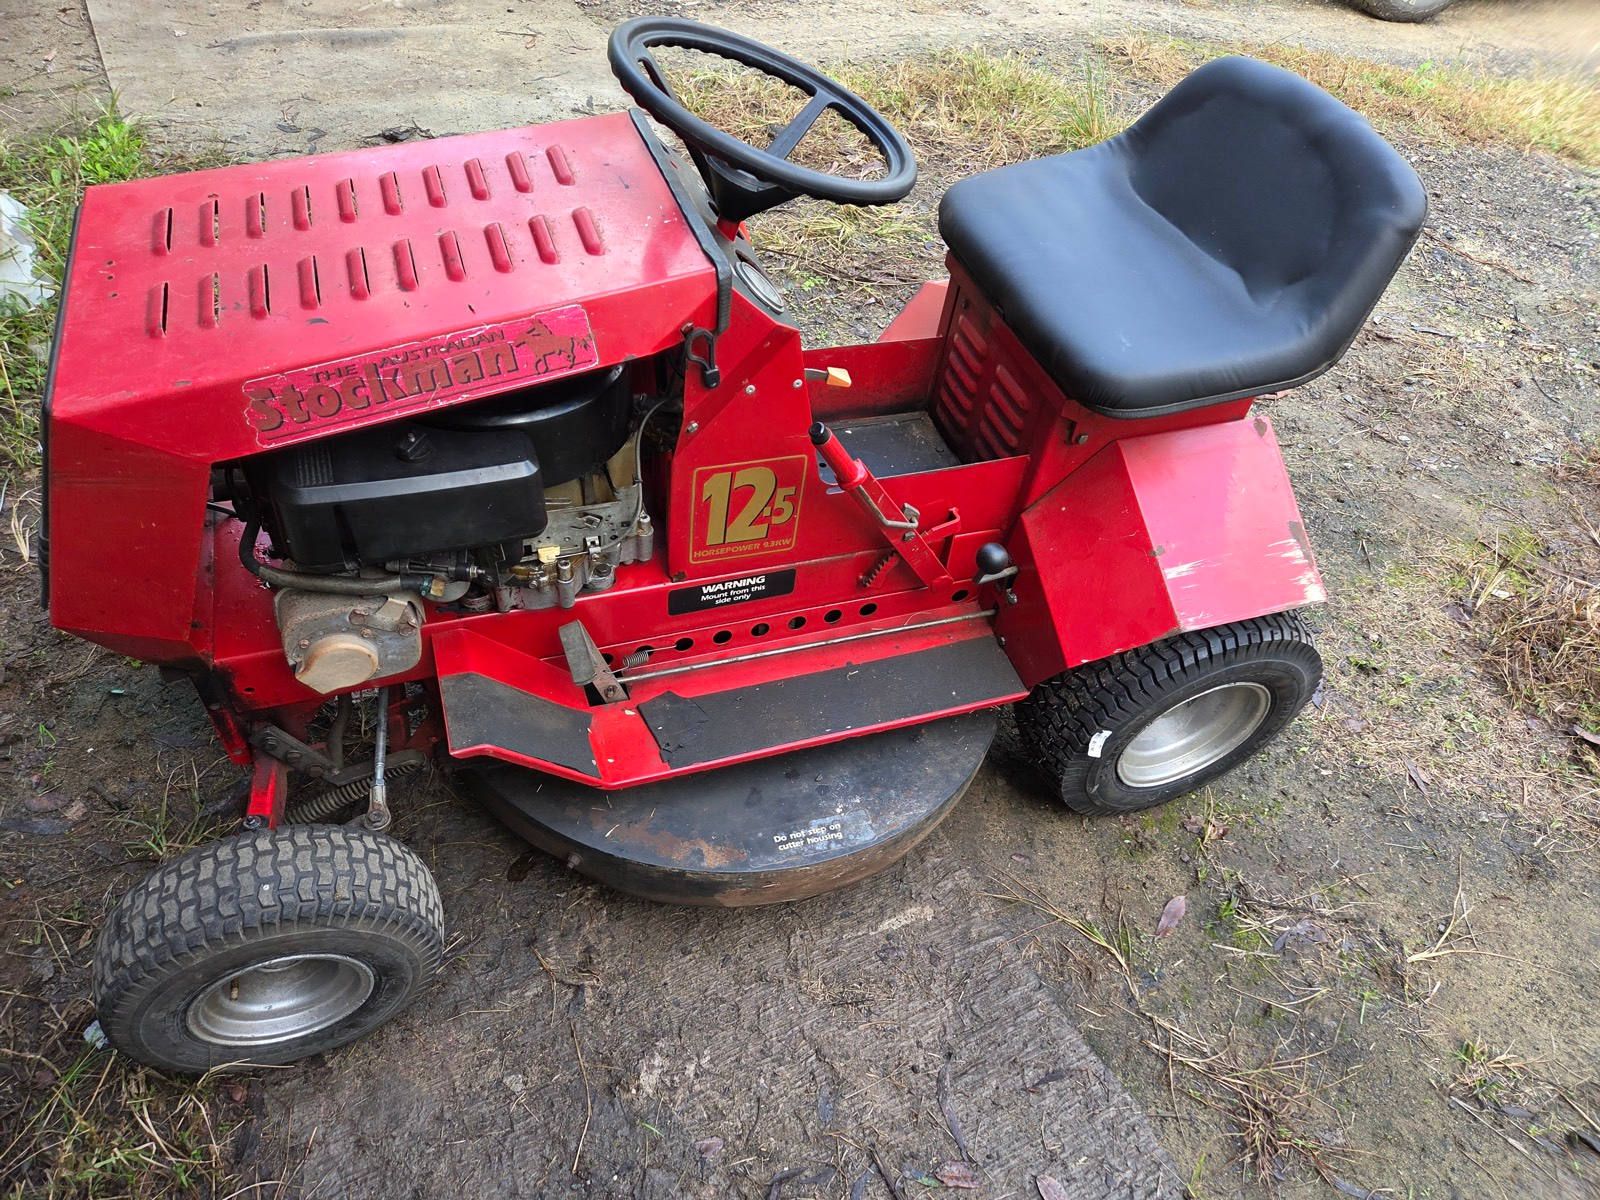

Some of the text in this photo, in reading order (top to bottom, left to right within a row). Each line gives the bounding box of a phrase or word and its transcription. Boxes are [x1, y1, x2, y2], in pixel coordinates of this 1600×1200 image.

[313, 329, 505, 383] THE AUSTRALIAN
[249, 341, 520, 432] Stockman
[693, 543, 761, 558] HORSEPOWER
[701, 584, 766, 602] Mount from this
[702, 575, 766, 594] WARNING
[715, 593, 752, 605] side only
[773, 823, 841, 843] Do not step on
[778, 832, 843, 851] cutter housing
